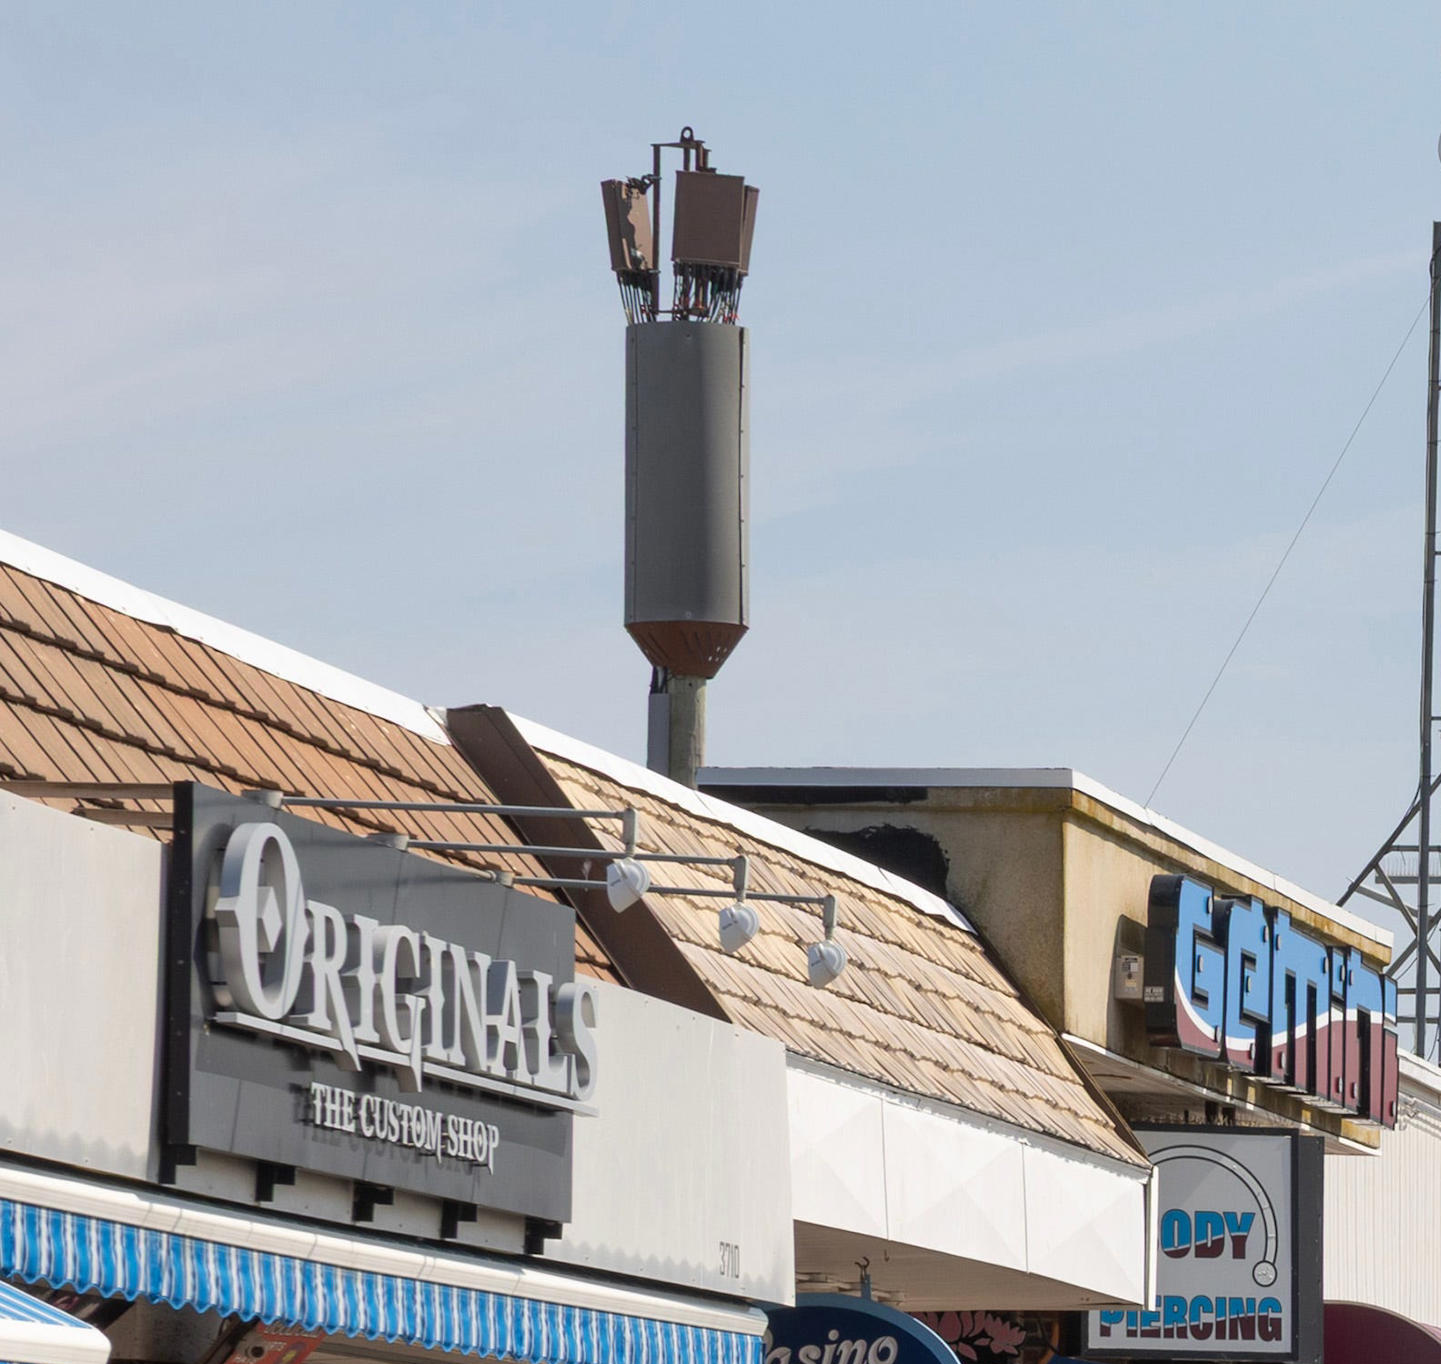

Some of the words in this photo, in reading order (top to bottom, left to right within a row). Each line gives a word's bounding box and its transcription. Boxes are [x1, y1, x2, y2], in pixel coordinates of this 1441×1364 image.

[213, 822, 600, 1105] ORIGINALS
[309, 1082, 357, 1134] THE
[359, 1093, 444, 1161] CUSTOM
[446, 1115, 501, 1175] SHOP
[1159, 1208, 1256, 1259] ODY
[718, 1240, 740, 1279] 3710
[1100, 1294, 1282, 1341] PIERCING
